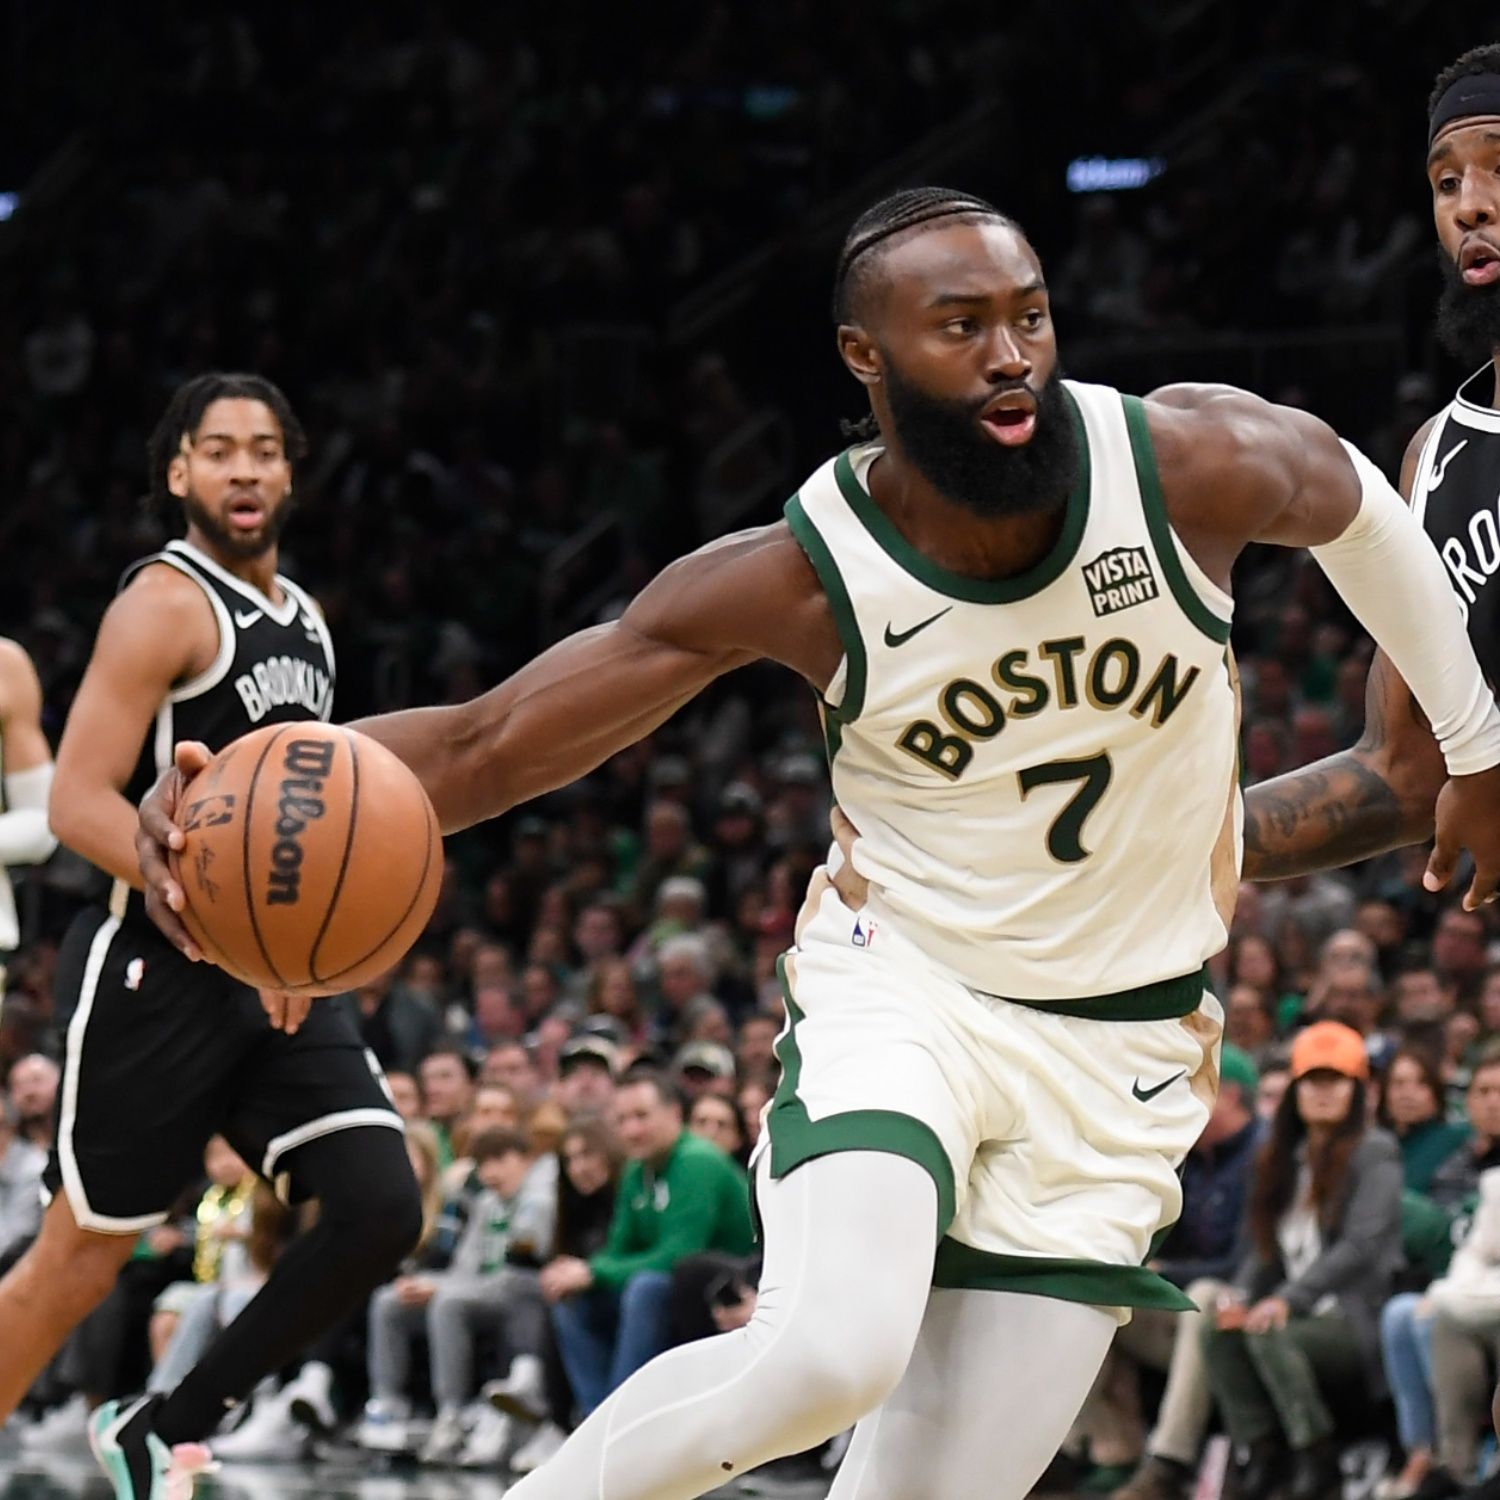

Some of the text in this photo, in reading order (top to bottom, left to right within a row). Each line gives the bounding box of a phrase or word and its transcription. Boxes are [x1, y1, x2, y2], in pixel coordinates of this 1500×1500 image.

[1085, 550, 1150, 592] VISTA
[1093, 576, 1154, 615] PRINT
[894, 635, 1201, 782] BOSTON
[266, 739, 335, 906] Wilson
[1016, 748, 1113, 864] 7
